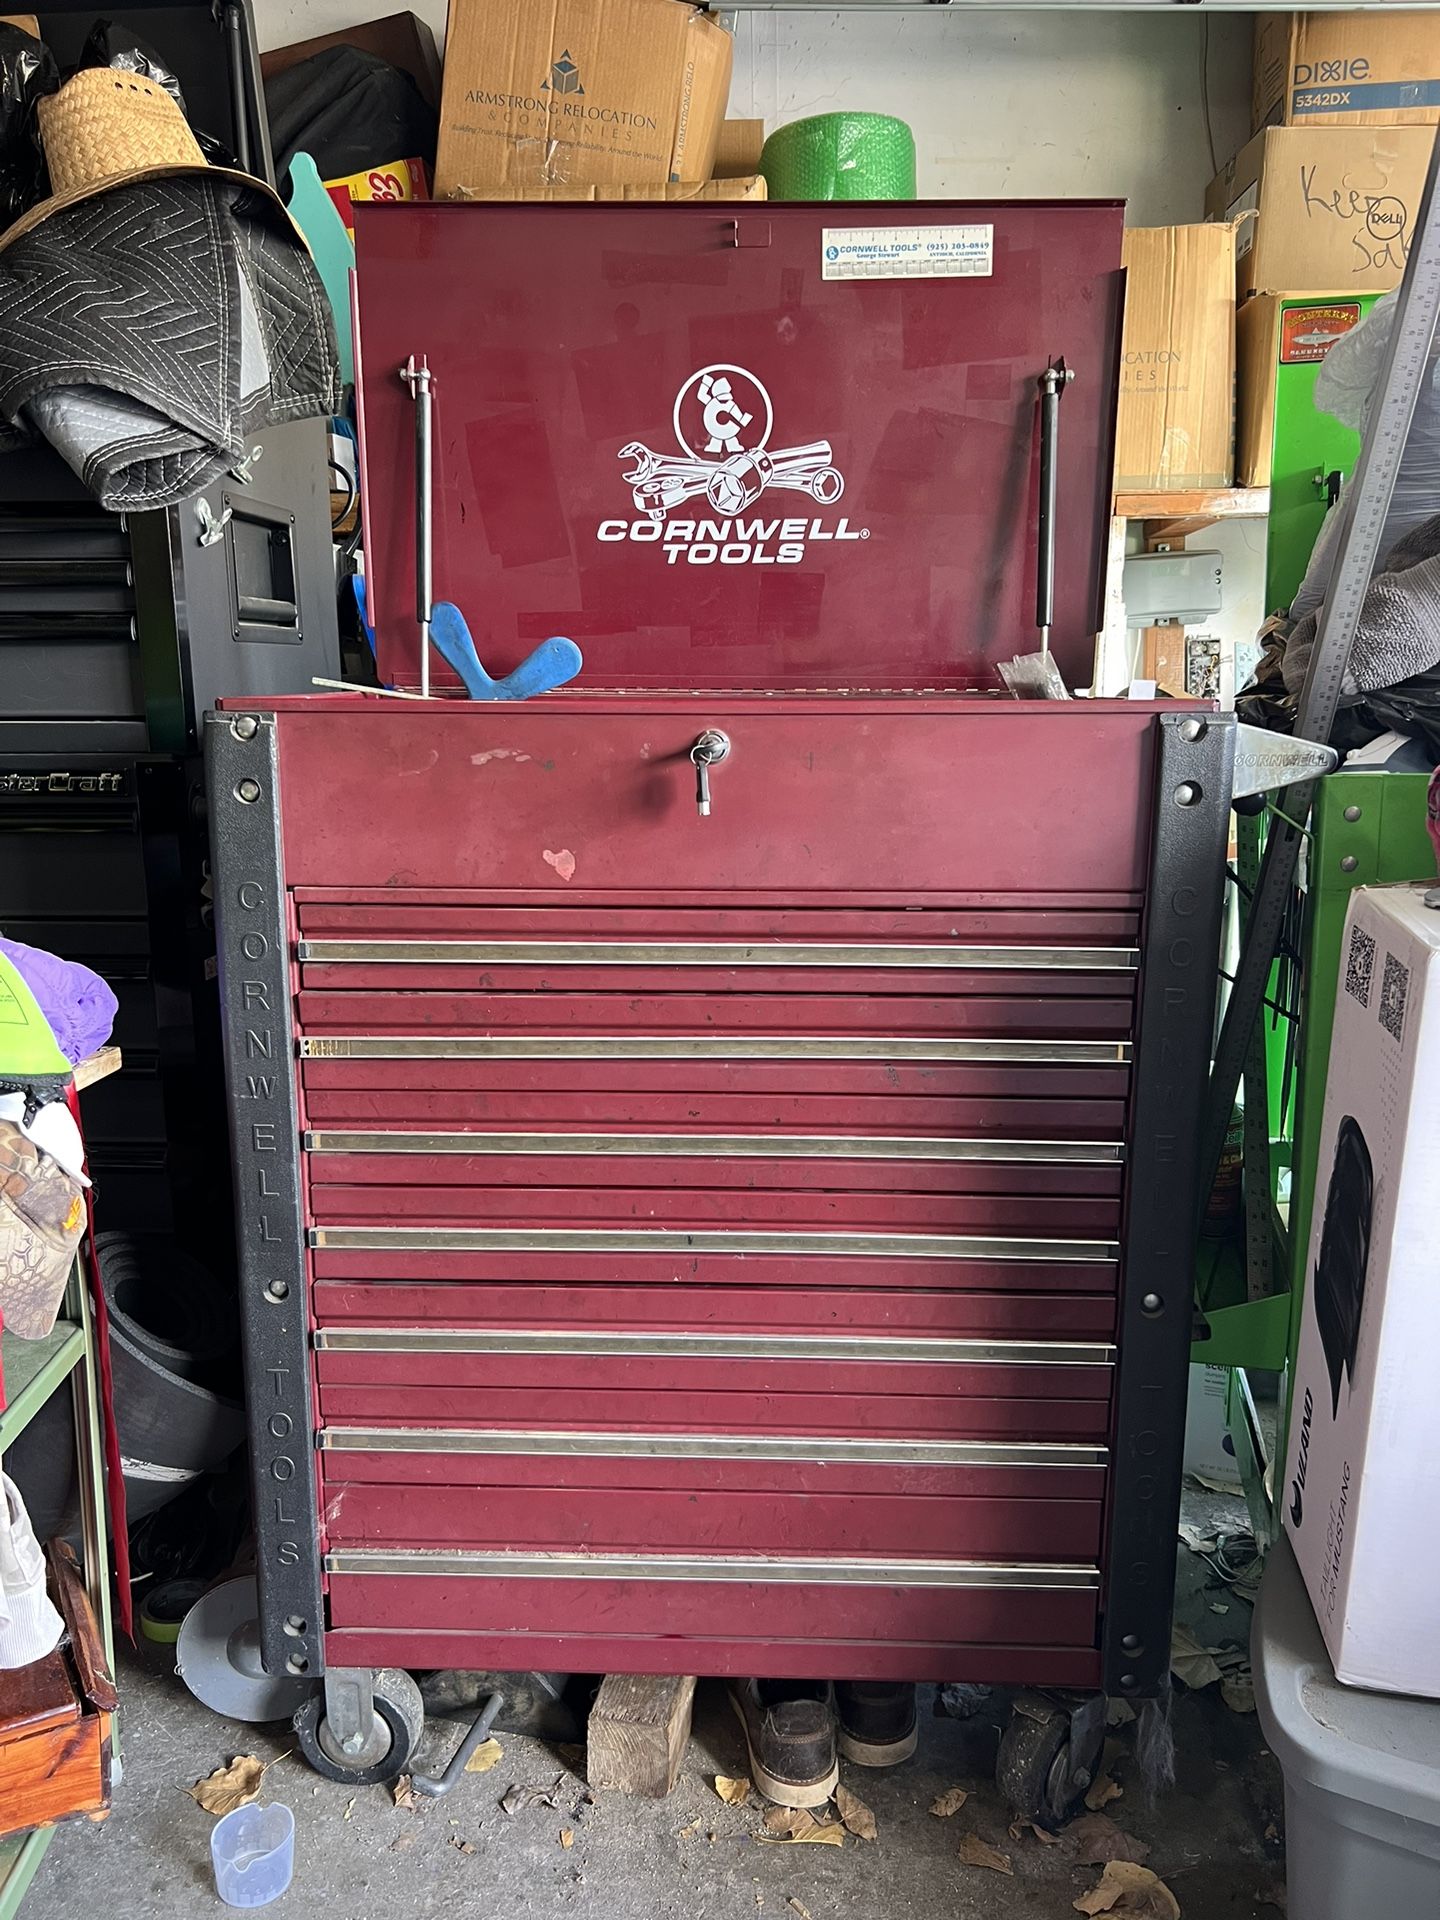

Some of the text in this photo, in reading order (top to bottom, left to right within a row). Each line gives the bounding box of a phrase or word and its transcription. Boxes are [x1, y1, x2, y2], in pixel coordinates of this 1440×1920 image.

[465, 89, 657, 130] ARMSTRONG RELOCATION
[1295, 92, 1350, 107] 5342DX
[504, 112, 632, 141] COMPANIES
[1301, 165, 1381, 219] Keep
[1371, 213, 1402, 226] DELL
[840, 243, 918, 254] CORNWELL TOOLS
[926, 242, 949, 251] (925)
[597, 518, 861, 542] CORNWELL
[662, 543, 805, 564] TOOLS
[1234, 752, 1328, 767] CORNWELL
[238, 881, 282, 1242] CORNWELL
[266, 1368, 300, 1566] TOOLS
[1333, 1461, 1351, 1579] MUSTANG
